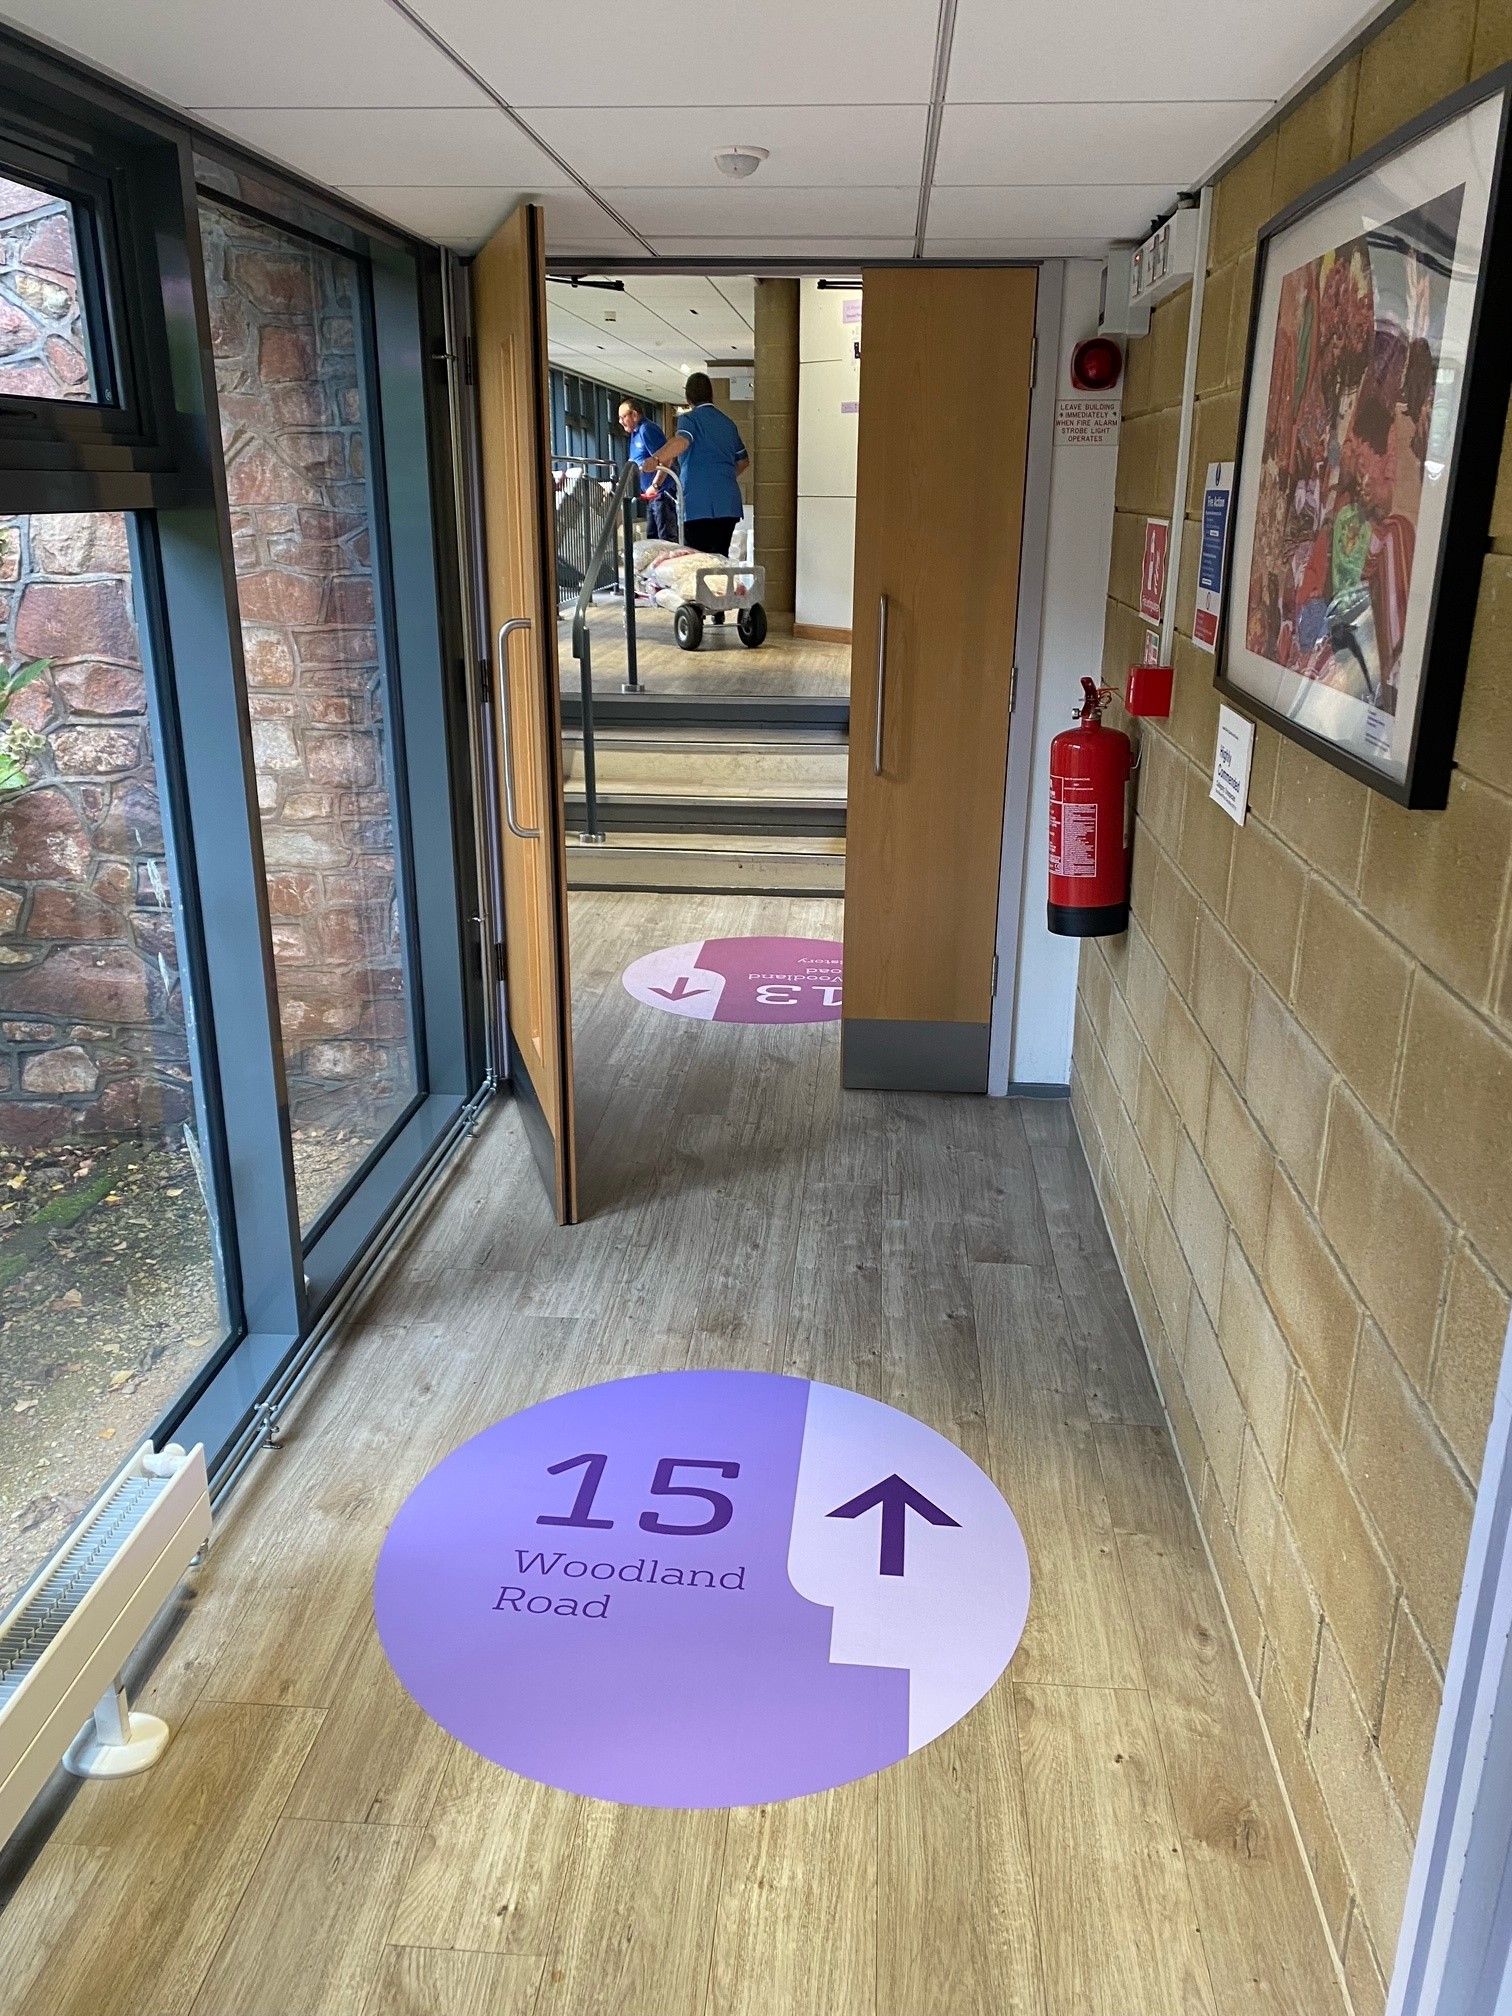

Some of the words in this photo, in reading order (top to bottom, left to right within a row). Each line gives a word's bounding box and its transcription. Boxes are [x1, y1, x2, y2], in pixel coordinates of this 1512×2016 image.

[797, 957, 843, 965] istory
[756, 984, 843, 1006] 13
[536, 1453, 741, 1536] 15
[514, 1549, 746, 1590] Woodland
[491, 1586, 611, 1619] Road
